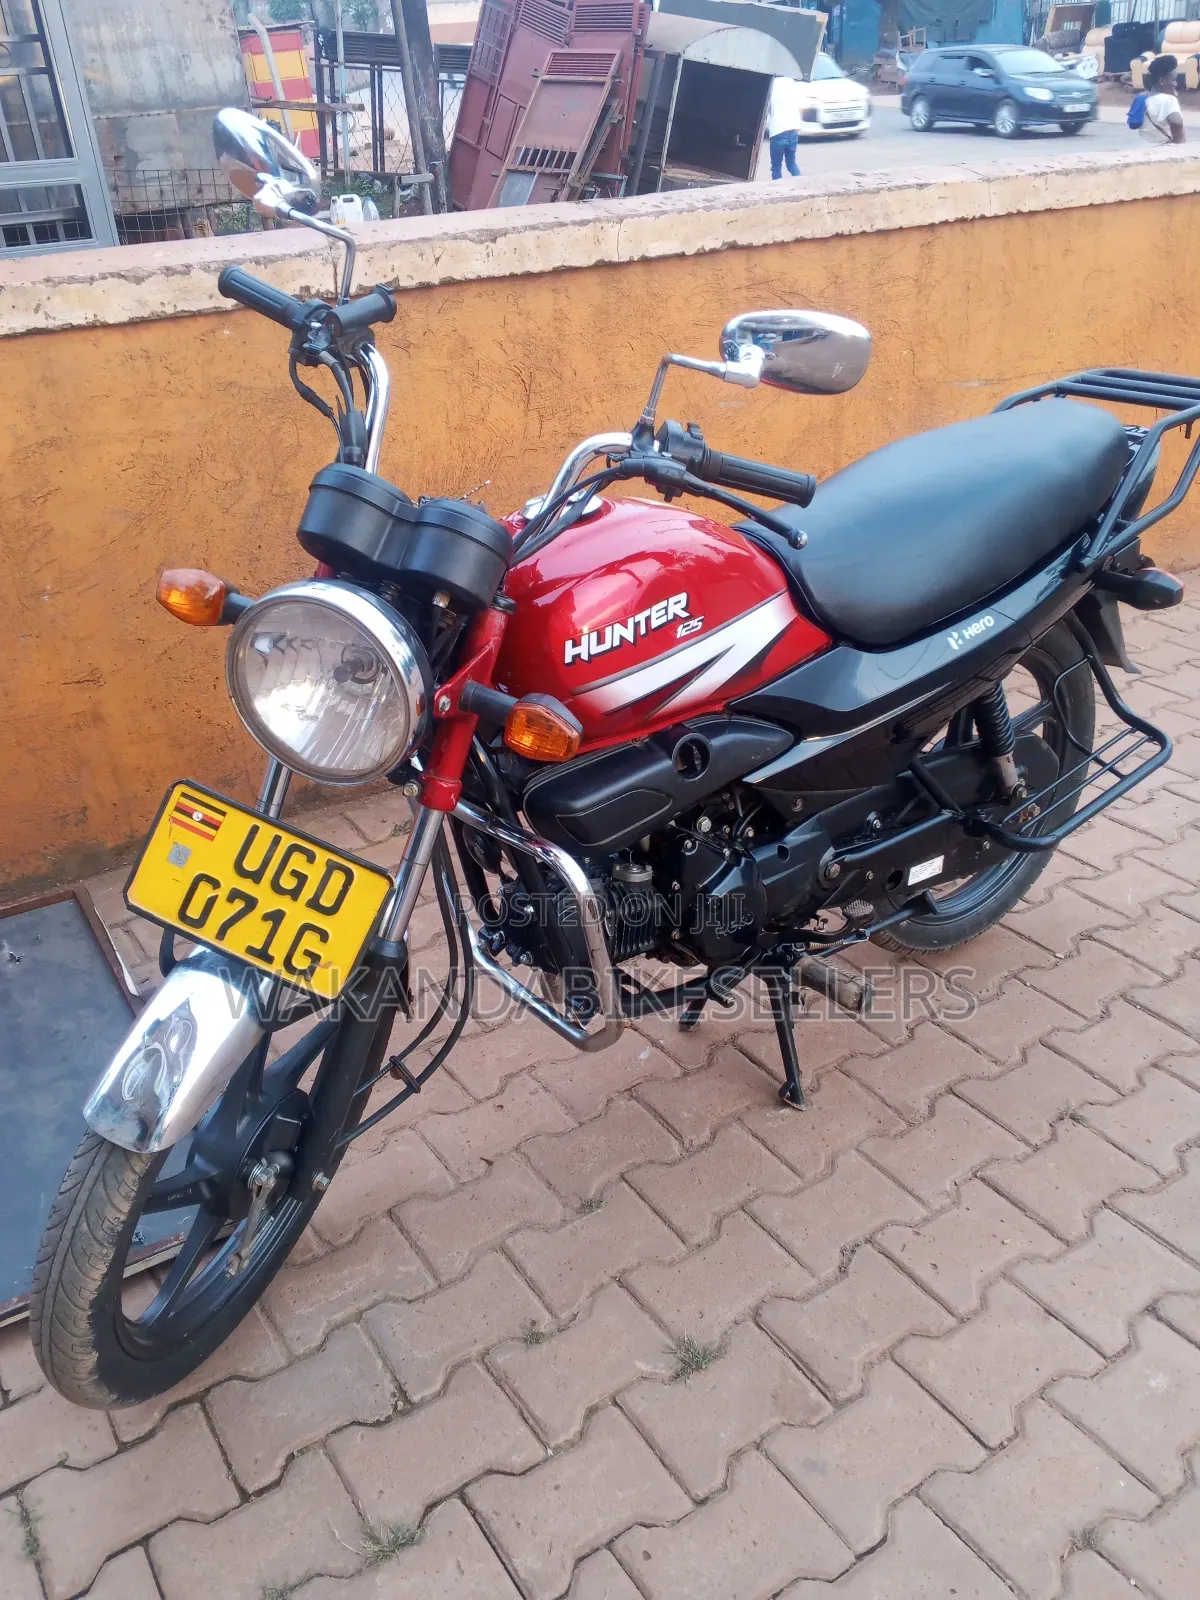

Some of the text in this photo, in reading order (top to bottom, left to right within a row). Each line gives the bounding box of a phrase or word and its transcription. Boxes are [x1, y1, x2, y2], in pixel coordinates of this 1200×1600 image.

[564, 591, 691, 666] HUNTER
[676, 615, 705, 639] 125
[962, 615, 995, 640] Hero
[233, 823, 355, 917] UGD
[177, 872, 330, 982] 071G
